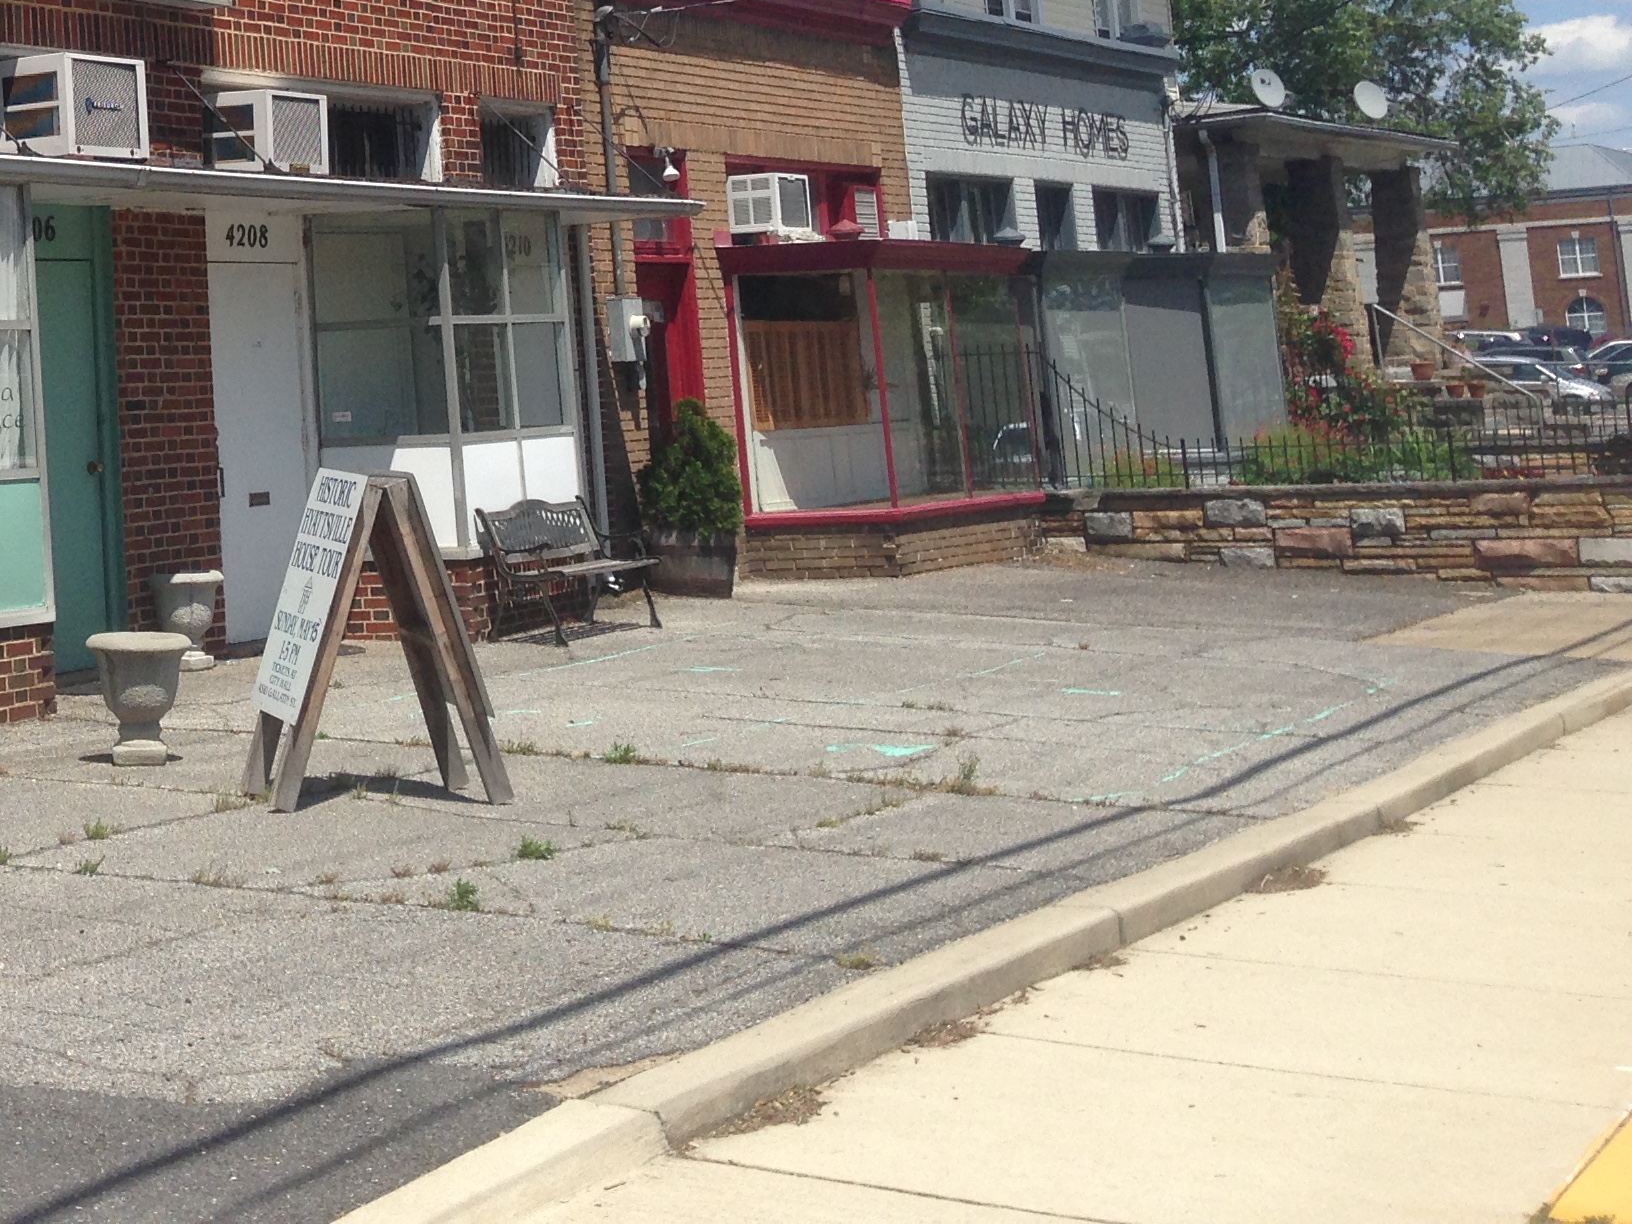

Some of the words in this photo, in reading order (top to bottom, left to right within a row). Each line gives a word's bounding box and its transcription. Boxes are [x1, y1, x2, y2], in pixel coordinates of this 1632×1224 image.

[961, 94, 1047, 148] GALAXY
[1061, 107, 1129, 160] HOMES
[226, 223, 268, 248] 4208
[316, 476, 357, 508] HISTORIC
[301, 508, 353, 544] HYATTSVILLE
[291, 541, 320, 573] HOUSE
[317, 547, 342, 579] TOUR
